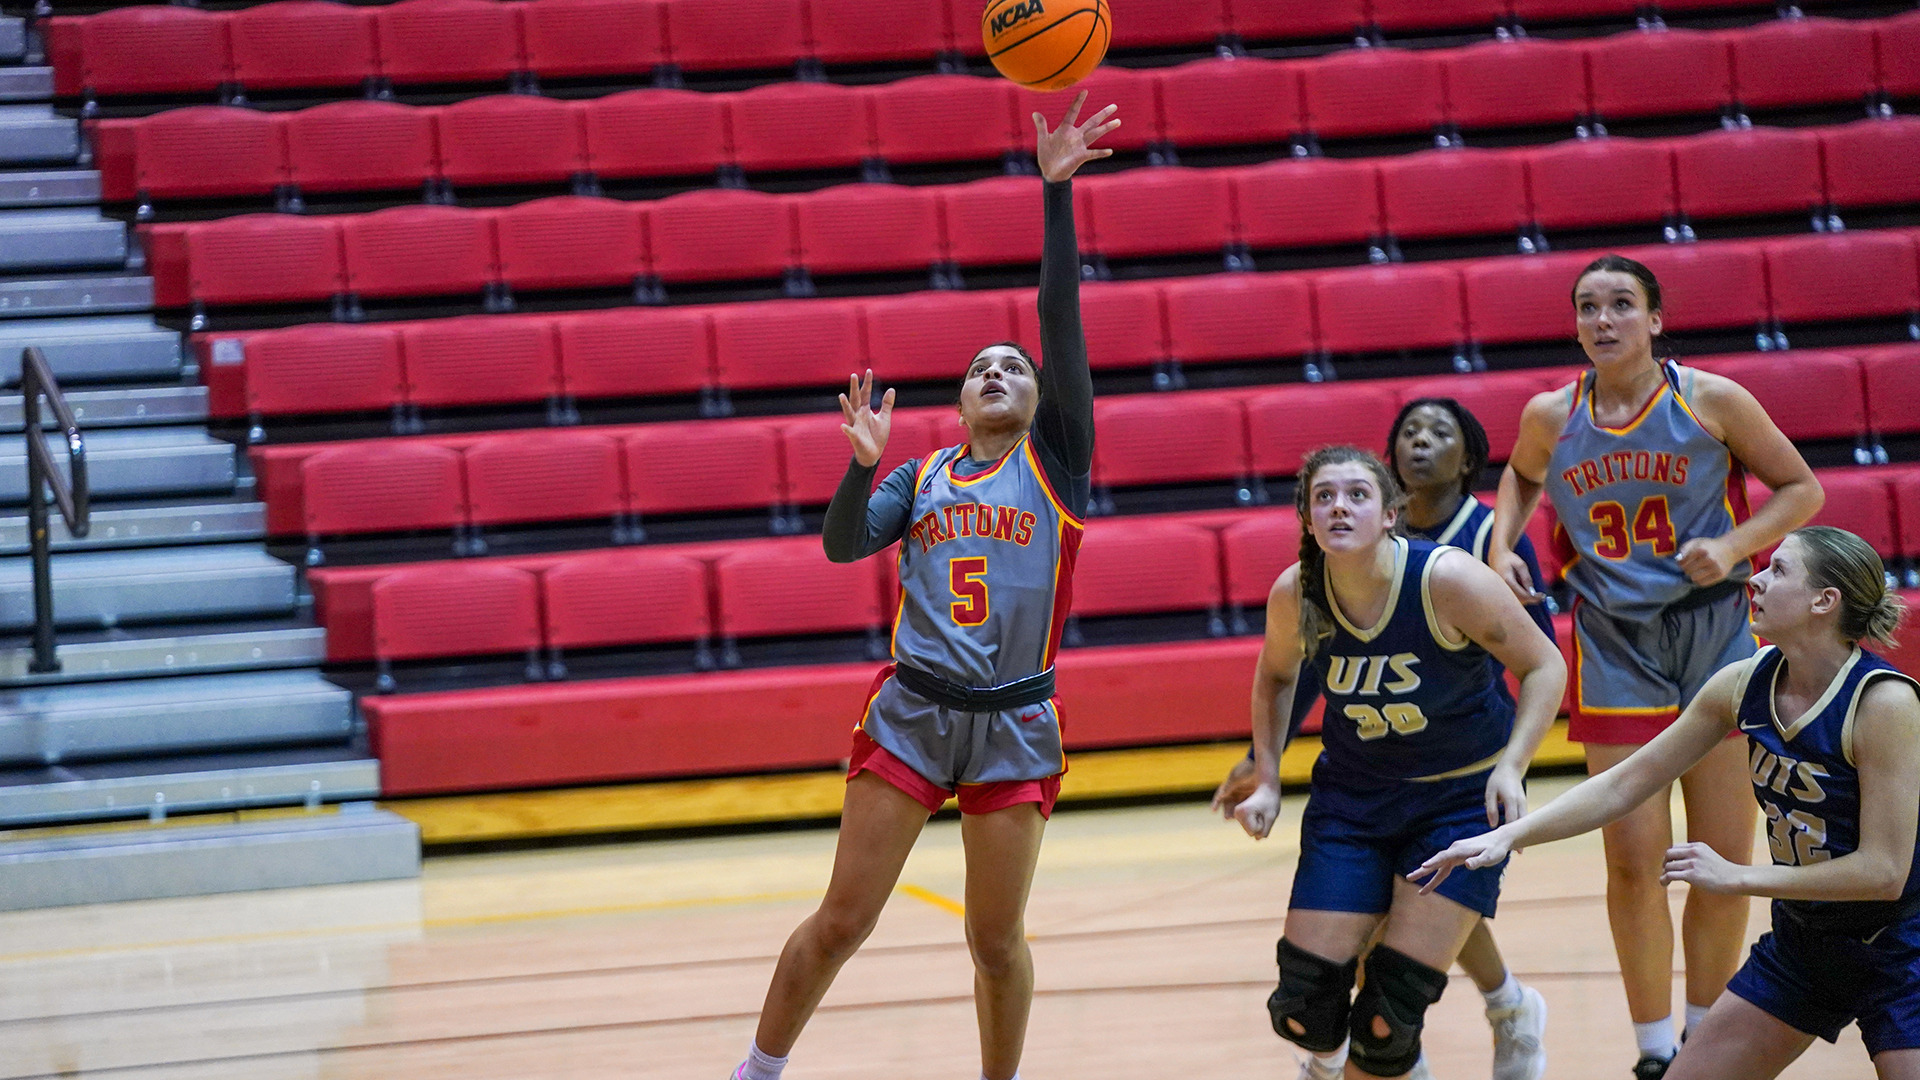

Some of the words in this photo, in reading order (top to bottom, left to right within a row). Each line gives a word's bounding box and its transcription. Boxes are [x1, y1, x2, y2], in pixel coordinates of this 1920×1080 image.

[991, 0, 1044, 37] NCAA
[1562, 449, 1689, 496] TRITONS
[910, 502, 1037, 554] TRITONS
[1589, 494, 1676, 562] 34
[949, 556, 989, 626] 5
[1326, 652, 1421, 696] UIS
[1750, 742, 1831, 803] UIS
[1764, 800, 1832, 866] 32
